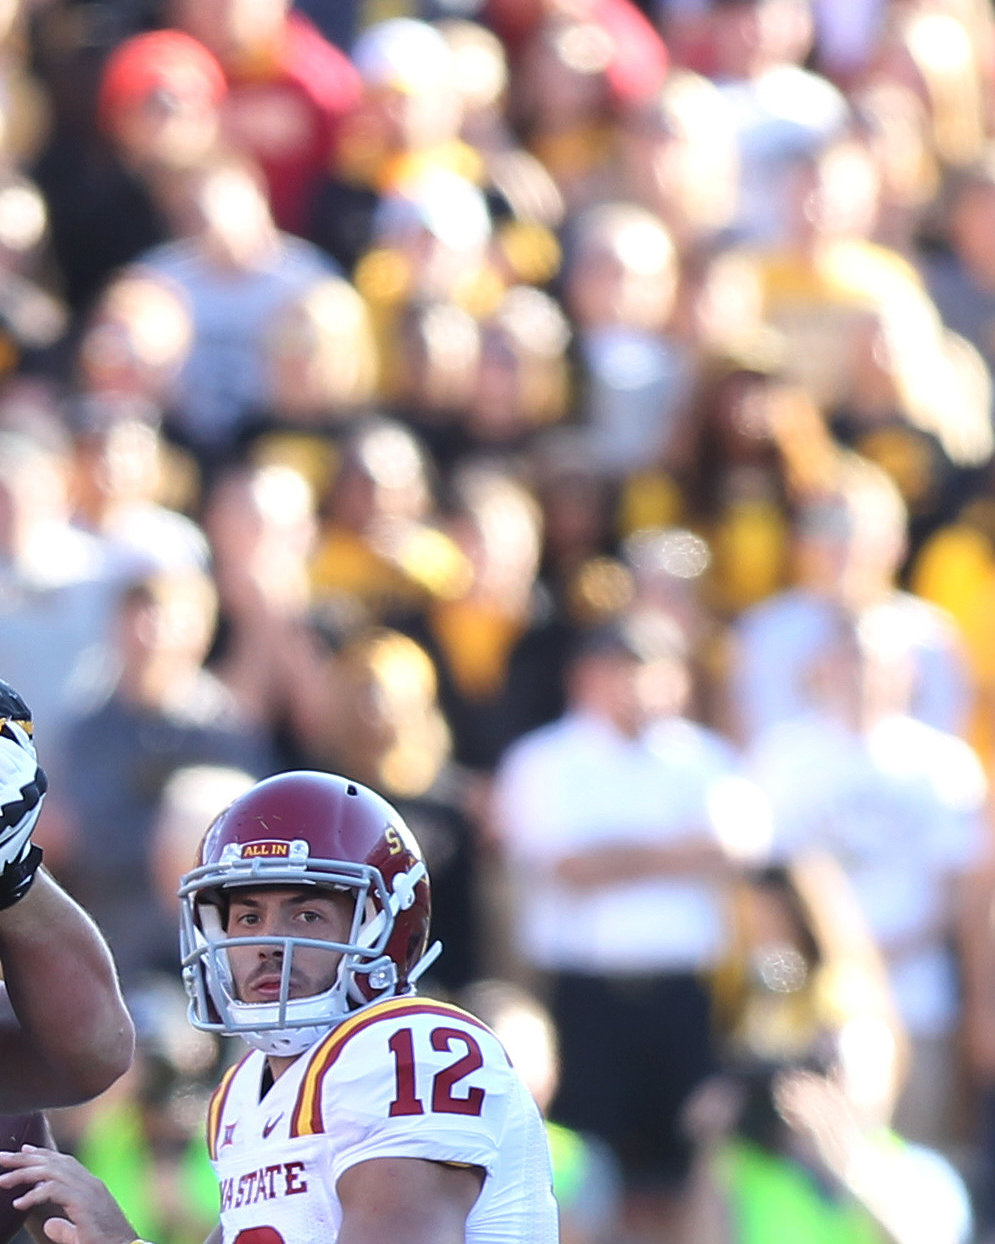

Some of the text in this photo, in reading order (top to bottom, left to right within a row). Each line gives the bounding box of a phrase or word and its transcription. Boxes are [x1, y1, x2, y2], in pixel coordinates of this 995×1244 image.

[244, 844, 287, 857] ALL IN
[388, 1027, 485, 1118] 12
[235, 1161, 307, 1209] STATE
